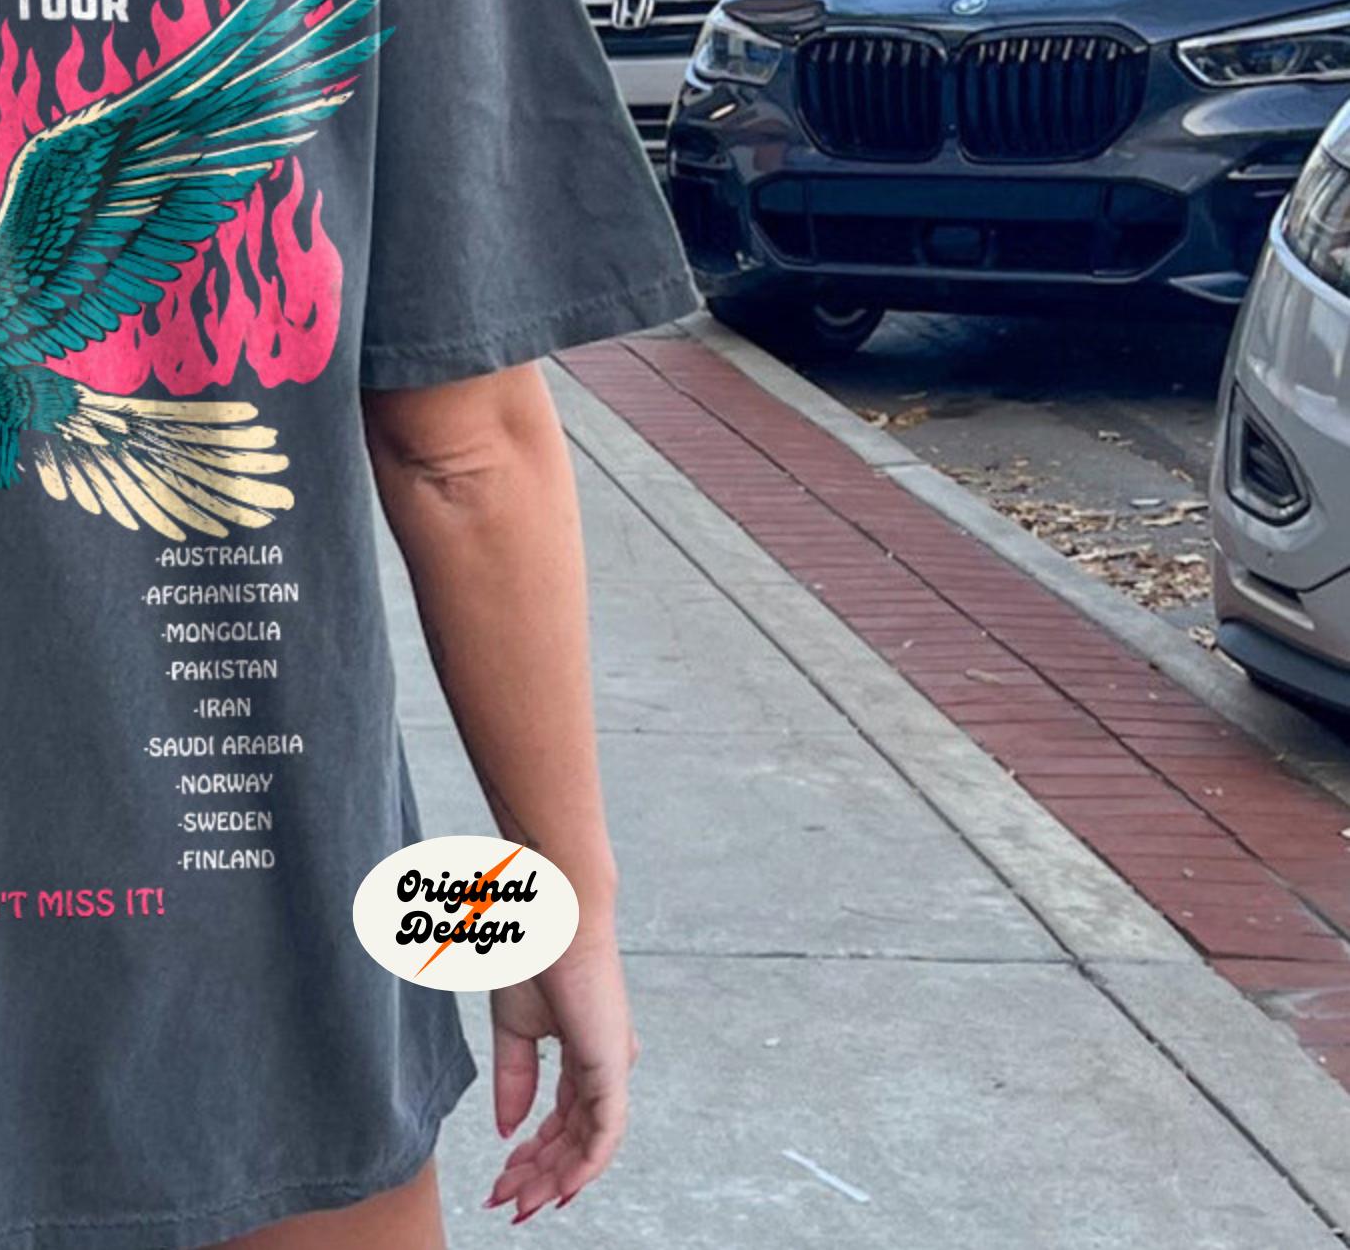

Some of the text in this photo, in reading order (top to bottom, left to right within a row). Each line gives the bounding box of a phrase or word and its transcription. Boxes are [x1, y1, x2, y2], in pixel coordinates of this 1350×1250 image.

[221, 735, 303, 755] ARABIA
[38, 889, 115, 918] MISS
[126, 888, 166, 916] IT!
